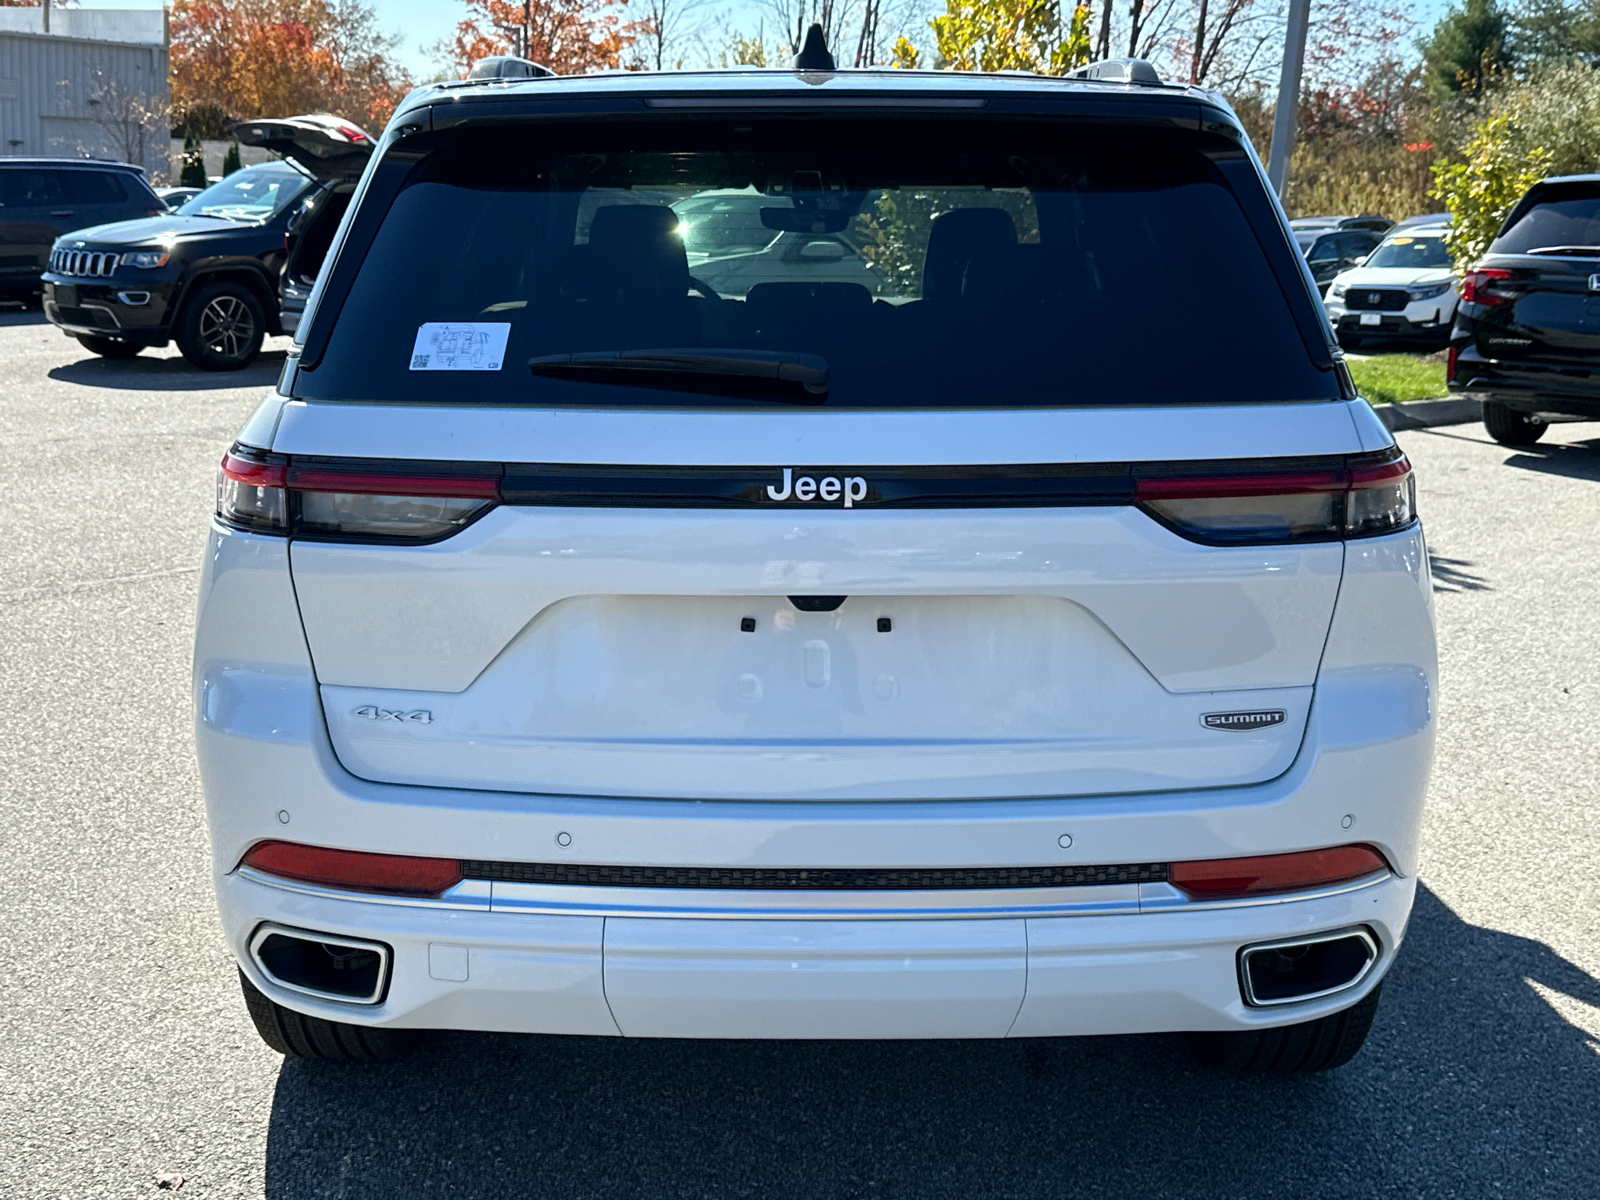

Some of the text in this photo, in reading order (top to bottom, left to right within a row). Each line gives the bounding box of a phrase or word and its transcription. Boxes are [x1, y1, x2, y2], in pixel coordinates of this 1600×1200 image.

[766, 467, 867, 508] Jeep
[351, 705, 434, 724] 4x4
[1206, 713, 1283, 725] SUMMIT
